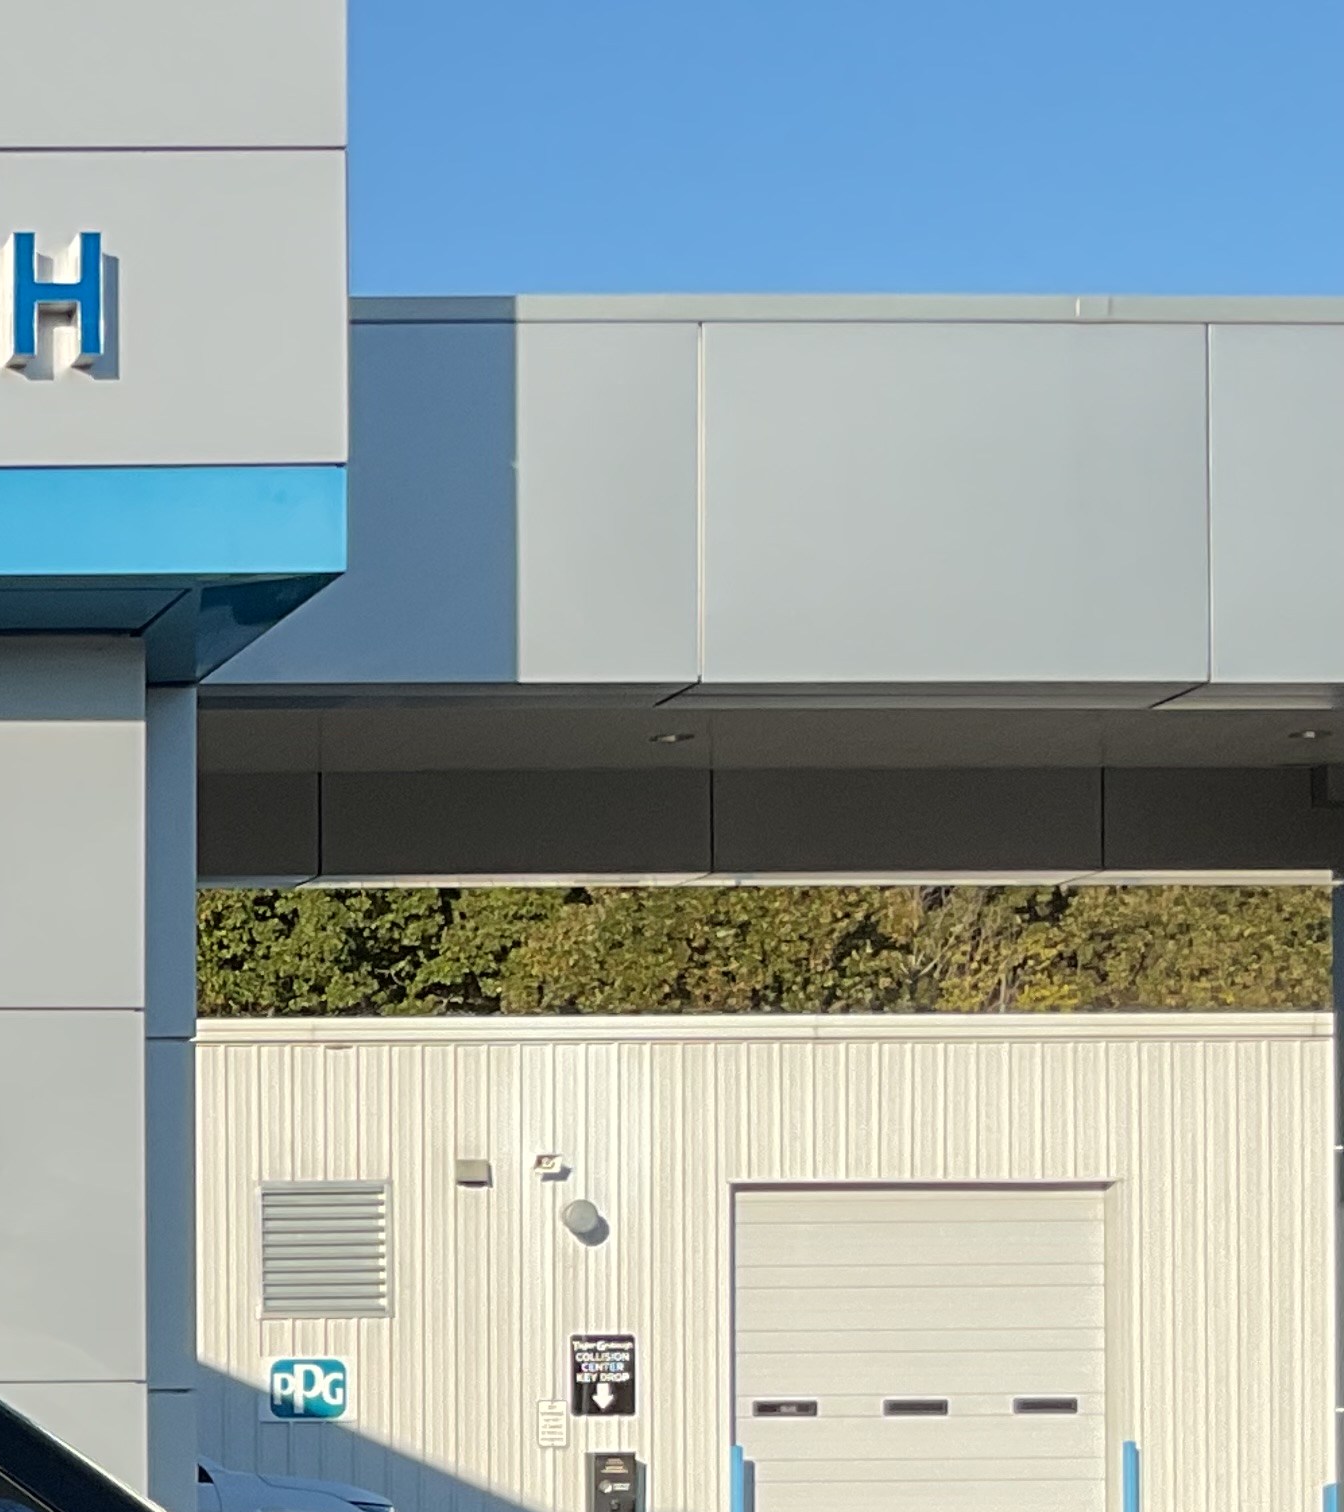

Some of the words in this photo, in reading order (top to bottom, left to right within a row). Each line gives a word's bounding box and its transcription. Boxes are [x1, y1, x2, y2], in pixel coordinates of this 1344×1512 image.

[575, 1352, 630, 1362] COLLISION
[581, 1362, 624, 1372] CENTER
[576, 1372, 598, 1382] KEY
[599, 1372, 630, 1382] DROP
[273, 1364, 344, 1414] PPG
